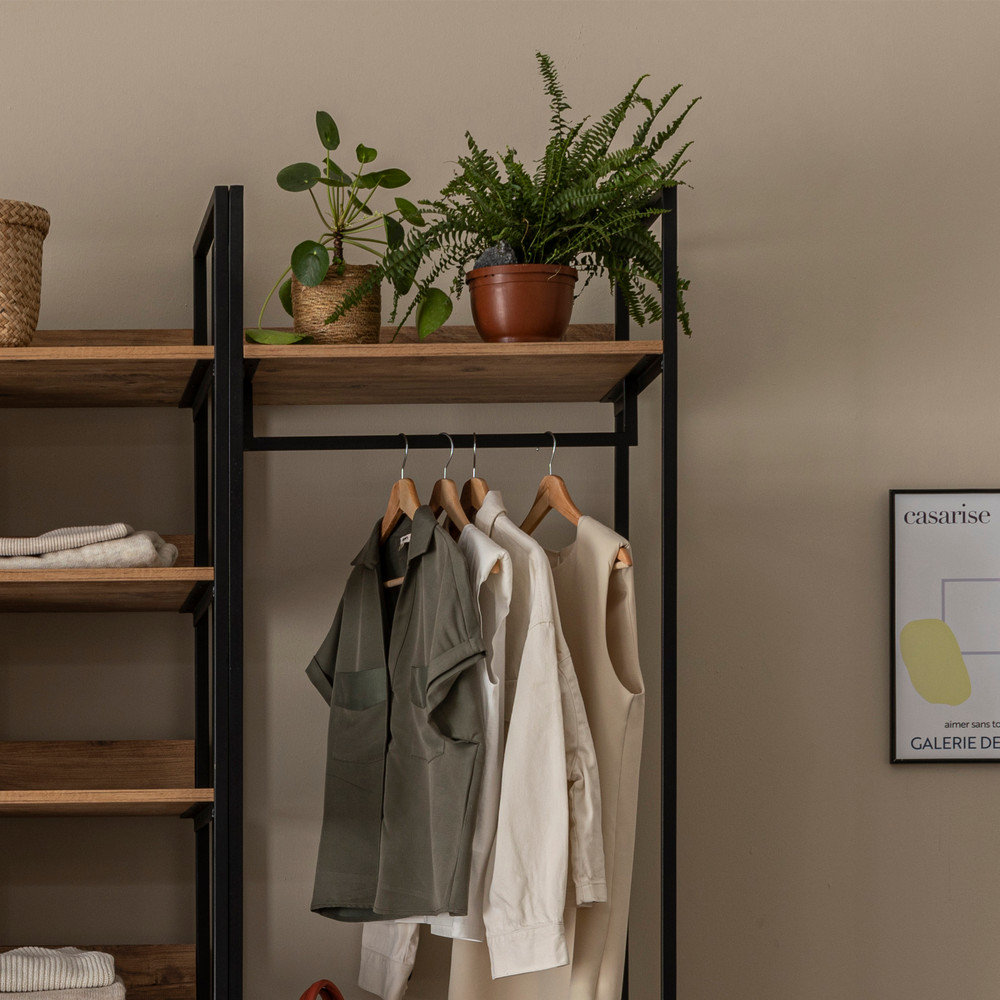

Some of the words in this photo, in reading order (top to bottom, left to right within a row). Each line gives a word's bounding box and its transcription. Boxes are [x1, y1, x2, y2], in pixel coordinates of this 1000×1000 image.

[903, 503, 991, 524] casarise
[944, 721, 969, 729] aimer
[971, 721, 991, 729] sans
[910, 736, 977, 750] GALERIE
[980, 736, 1000, 750] DE
